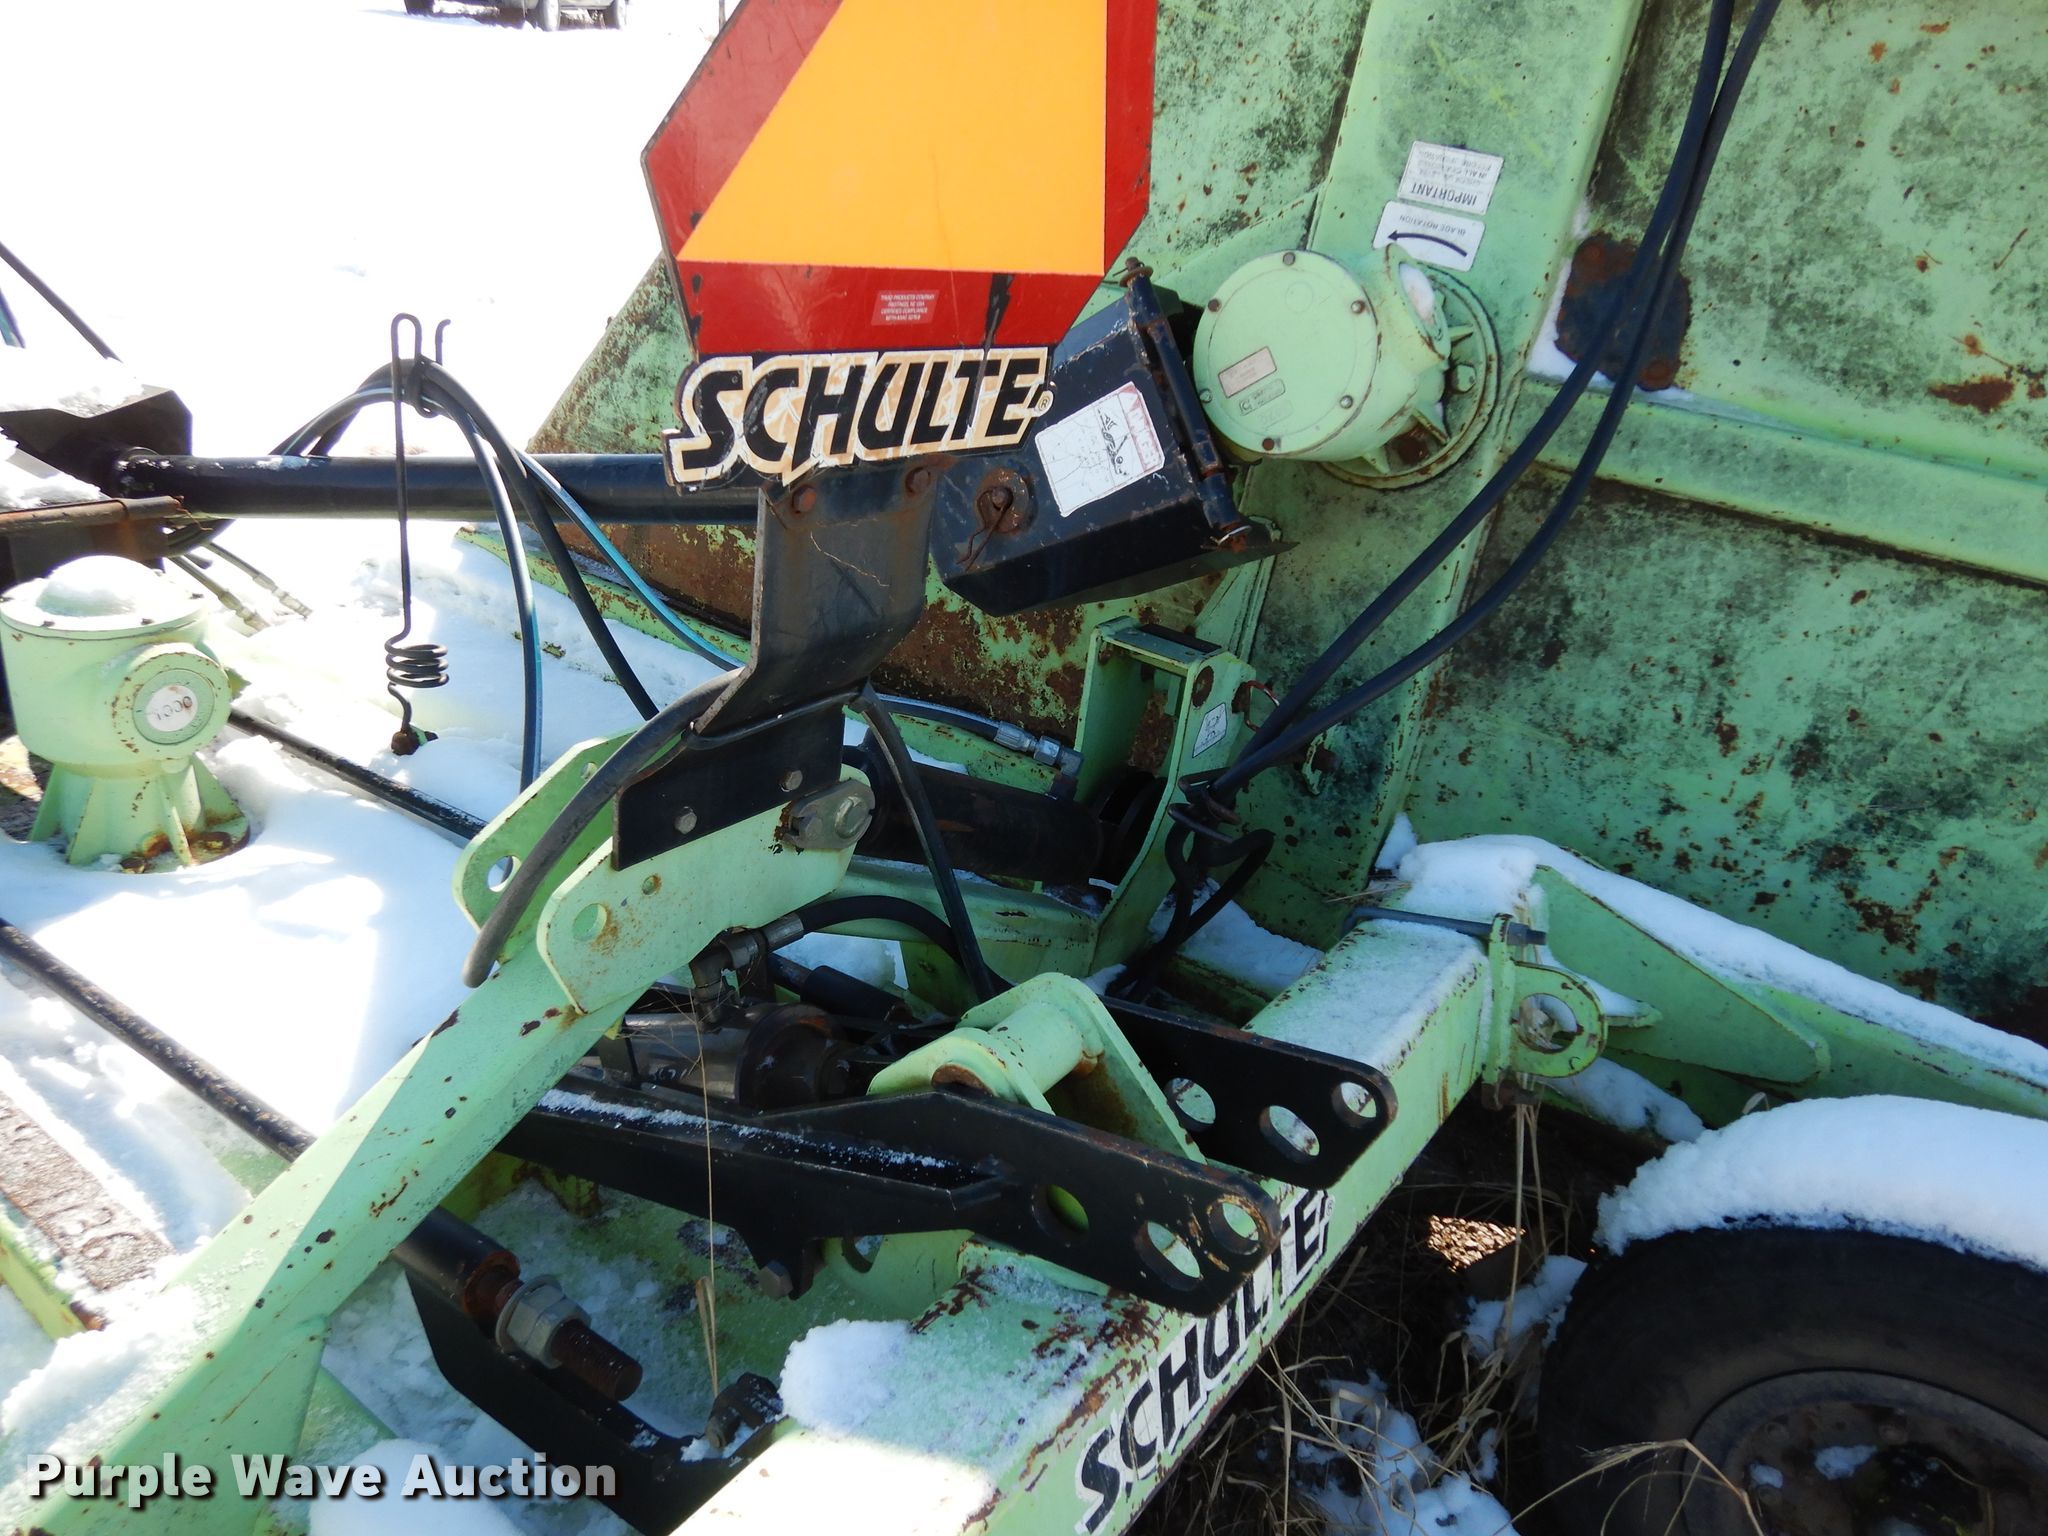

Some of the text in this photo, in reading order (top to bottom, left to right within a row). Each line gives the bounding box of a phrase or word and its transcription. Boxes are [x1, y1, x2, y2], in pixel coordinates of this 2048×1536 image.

[1410, 182, 1478, 206] IMPORTANT
[1399, 214, 1439, 229] ROTATION
[677, 351, 1046, 480] SCHULTE
